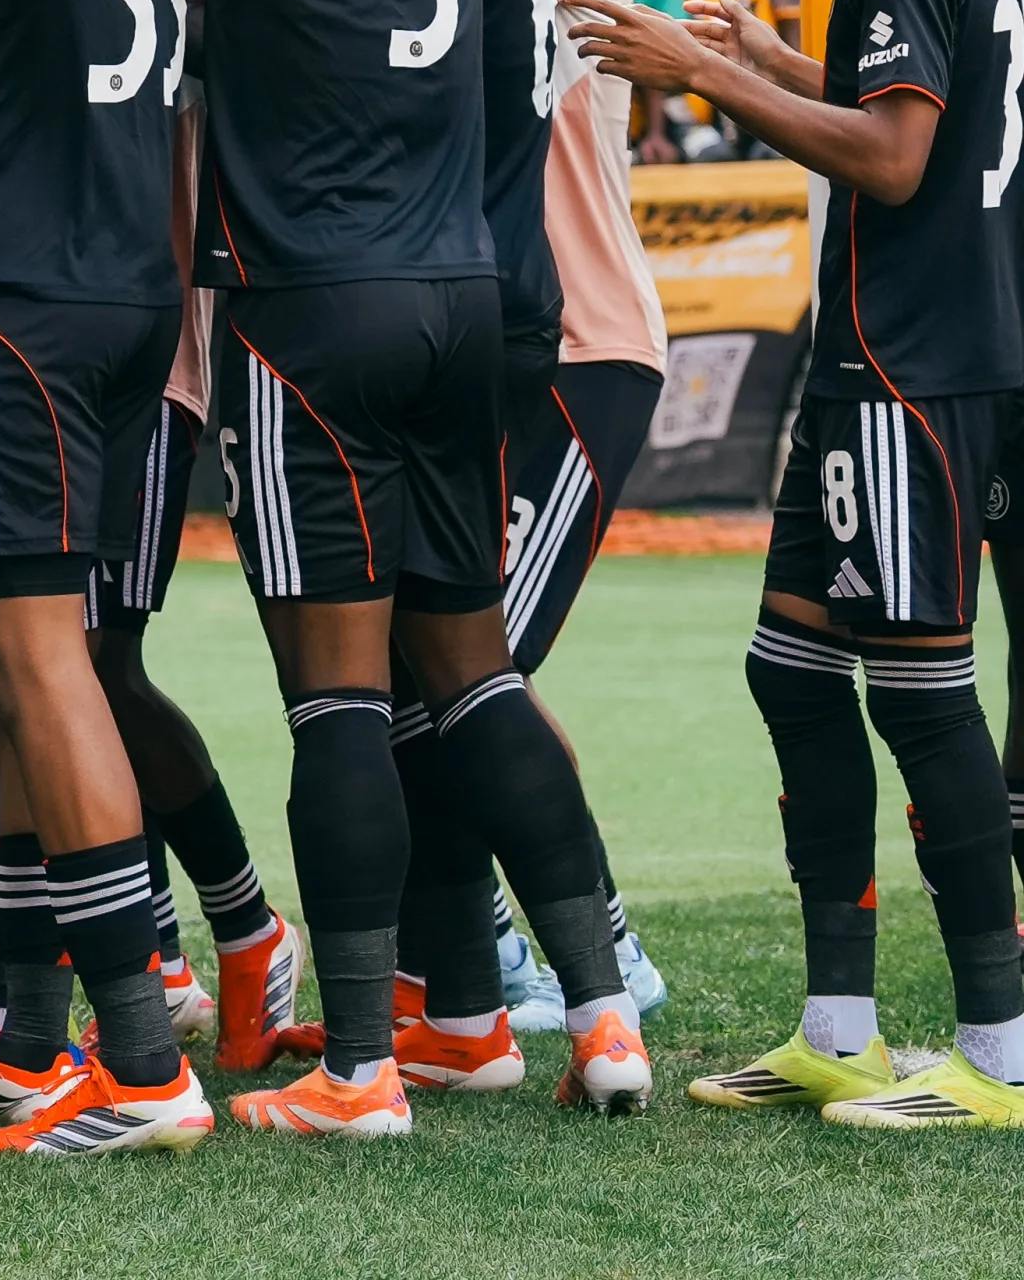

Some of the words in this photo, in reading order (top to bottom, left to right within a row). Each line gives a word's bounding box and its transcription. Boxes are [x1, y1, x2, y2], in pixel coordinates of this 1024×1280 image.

[858, 41, 910, 73] SUZUKI
[219, 427, 240, 518] 5
[820, 450, 859, 543] 8
